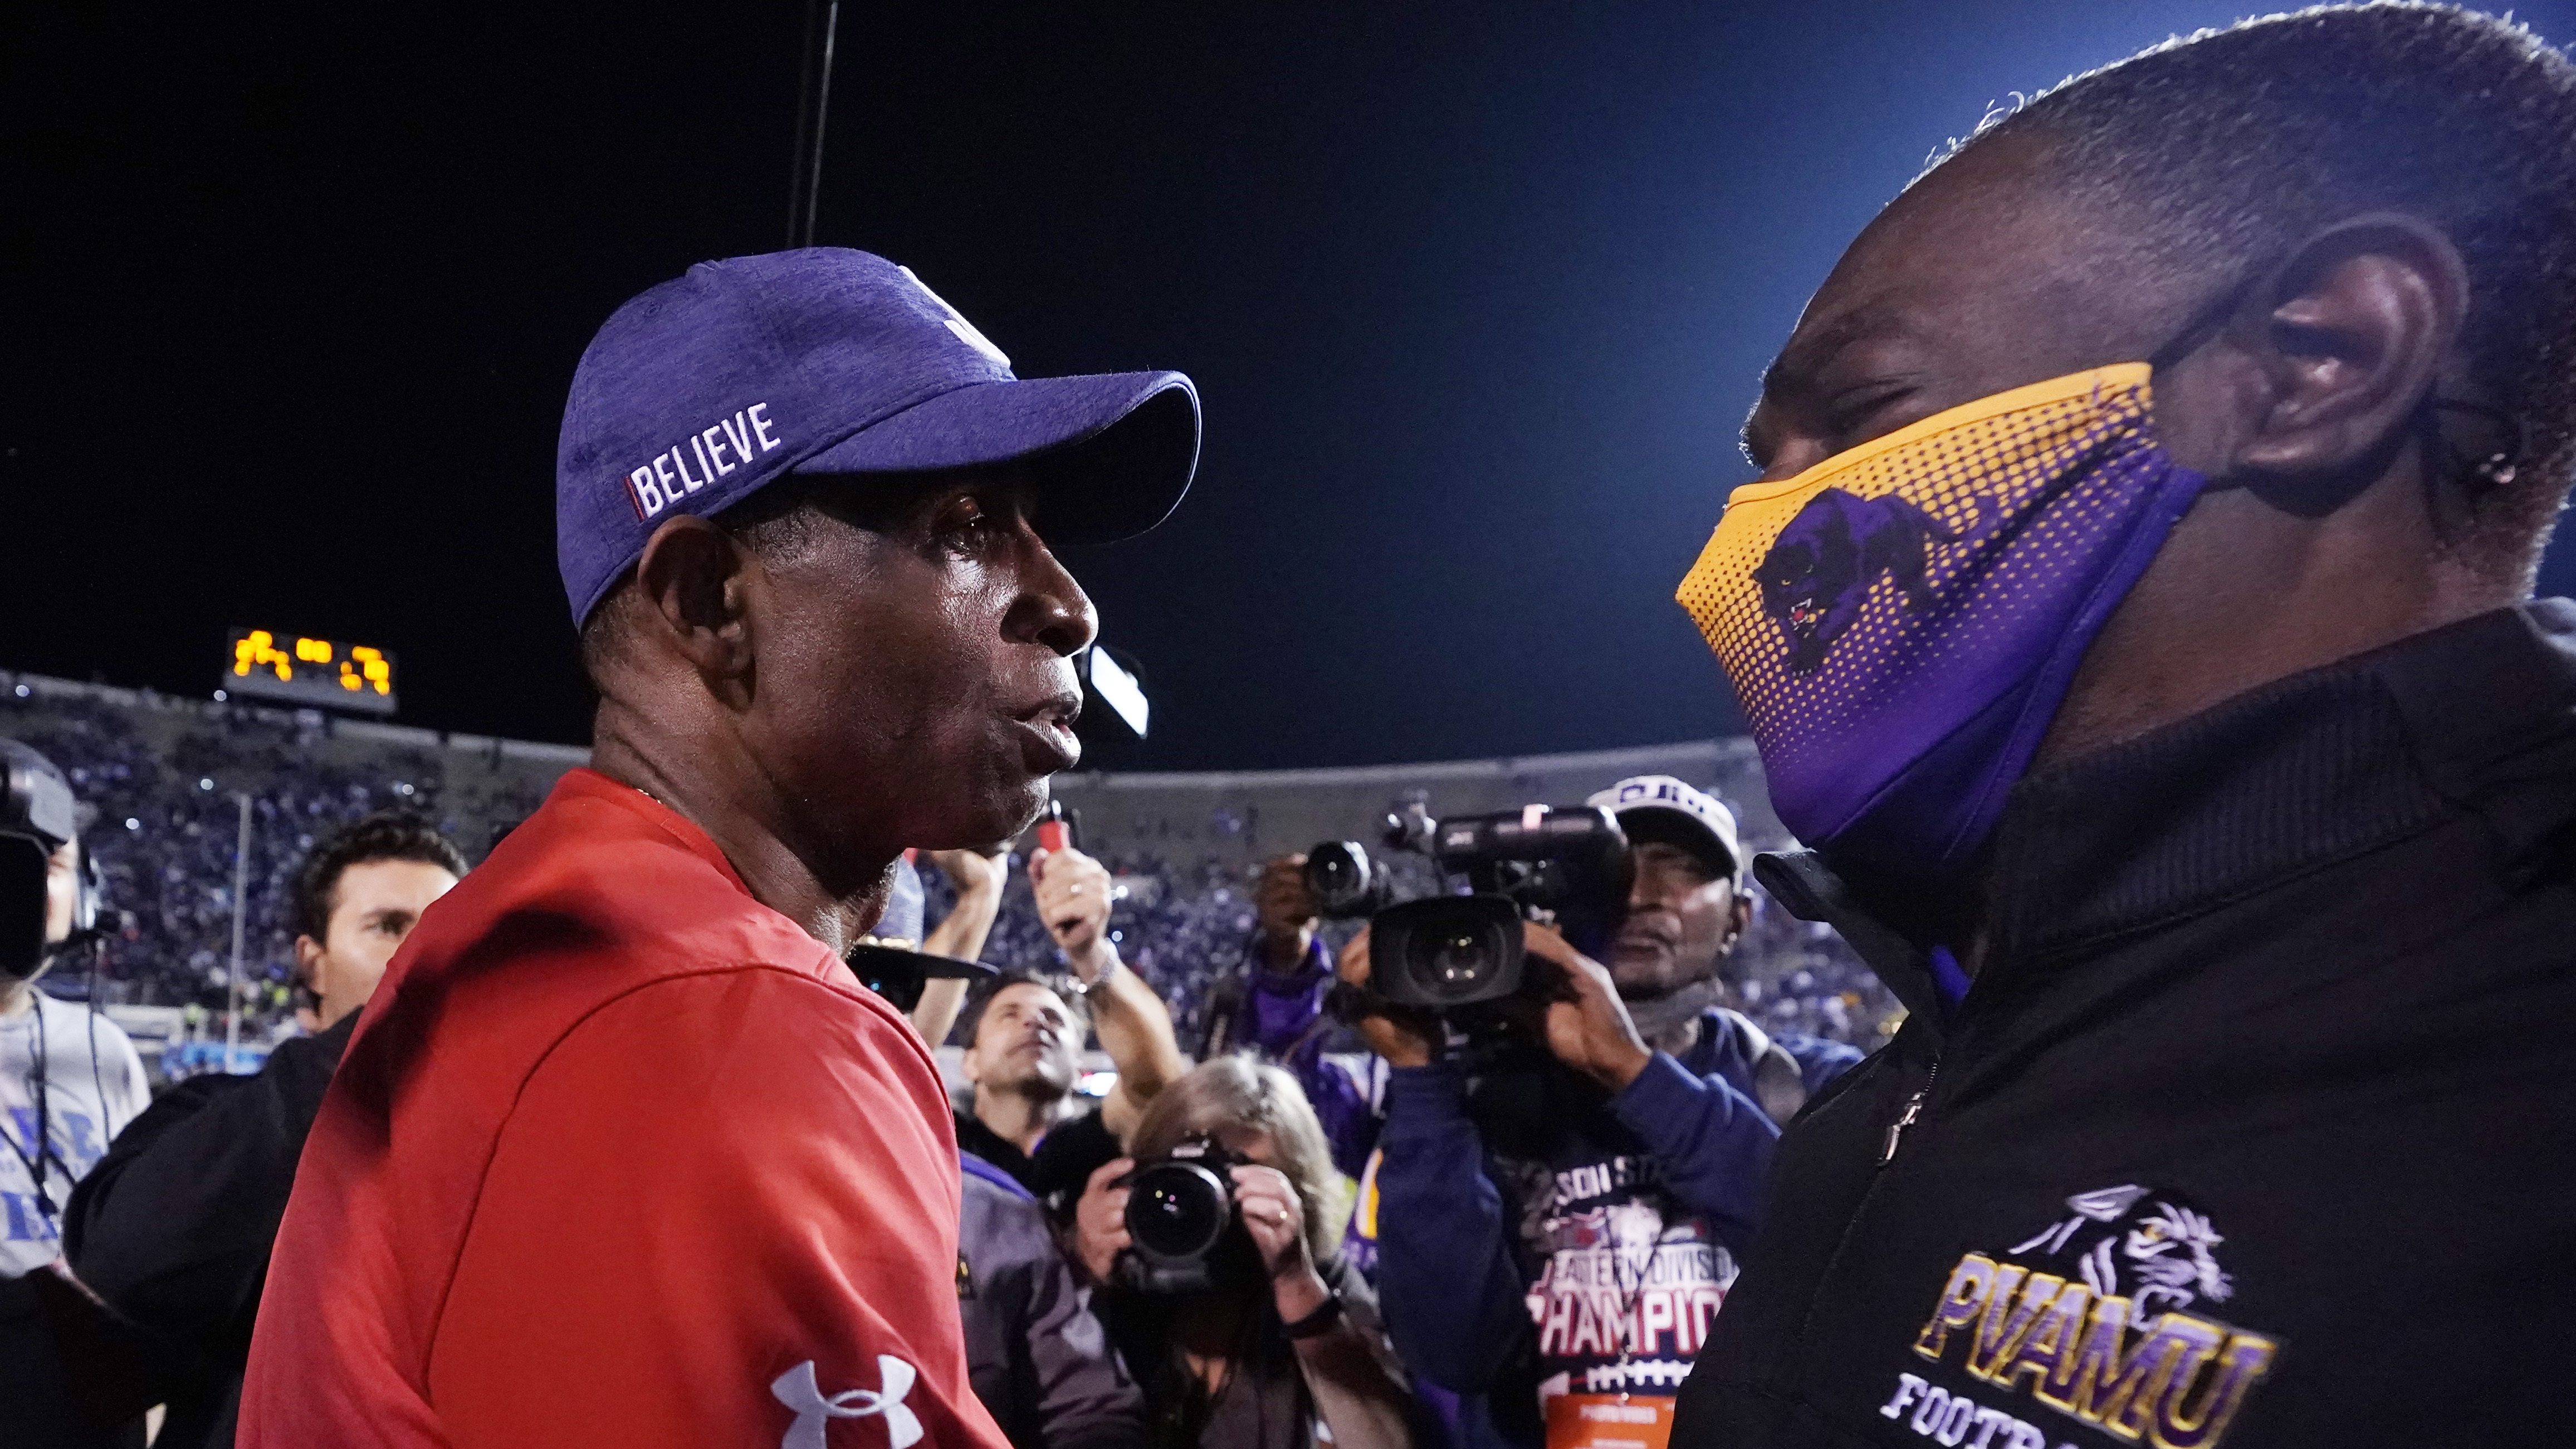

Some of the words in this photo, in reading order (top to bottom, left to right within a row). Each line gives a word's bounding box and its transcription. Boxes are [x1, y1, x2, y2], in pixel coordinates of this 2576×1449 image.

[630, 402, 781, 518] BELIEVE
[1913, 1253, 2277, 1449] PVAMU
[1880, 1372, 2080, 1449] FOOTB
